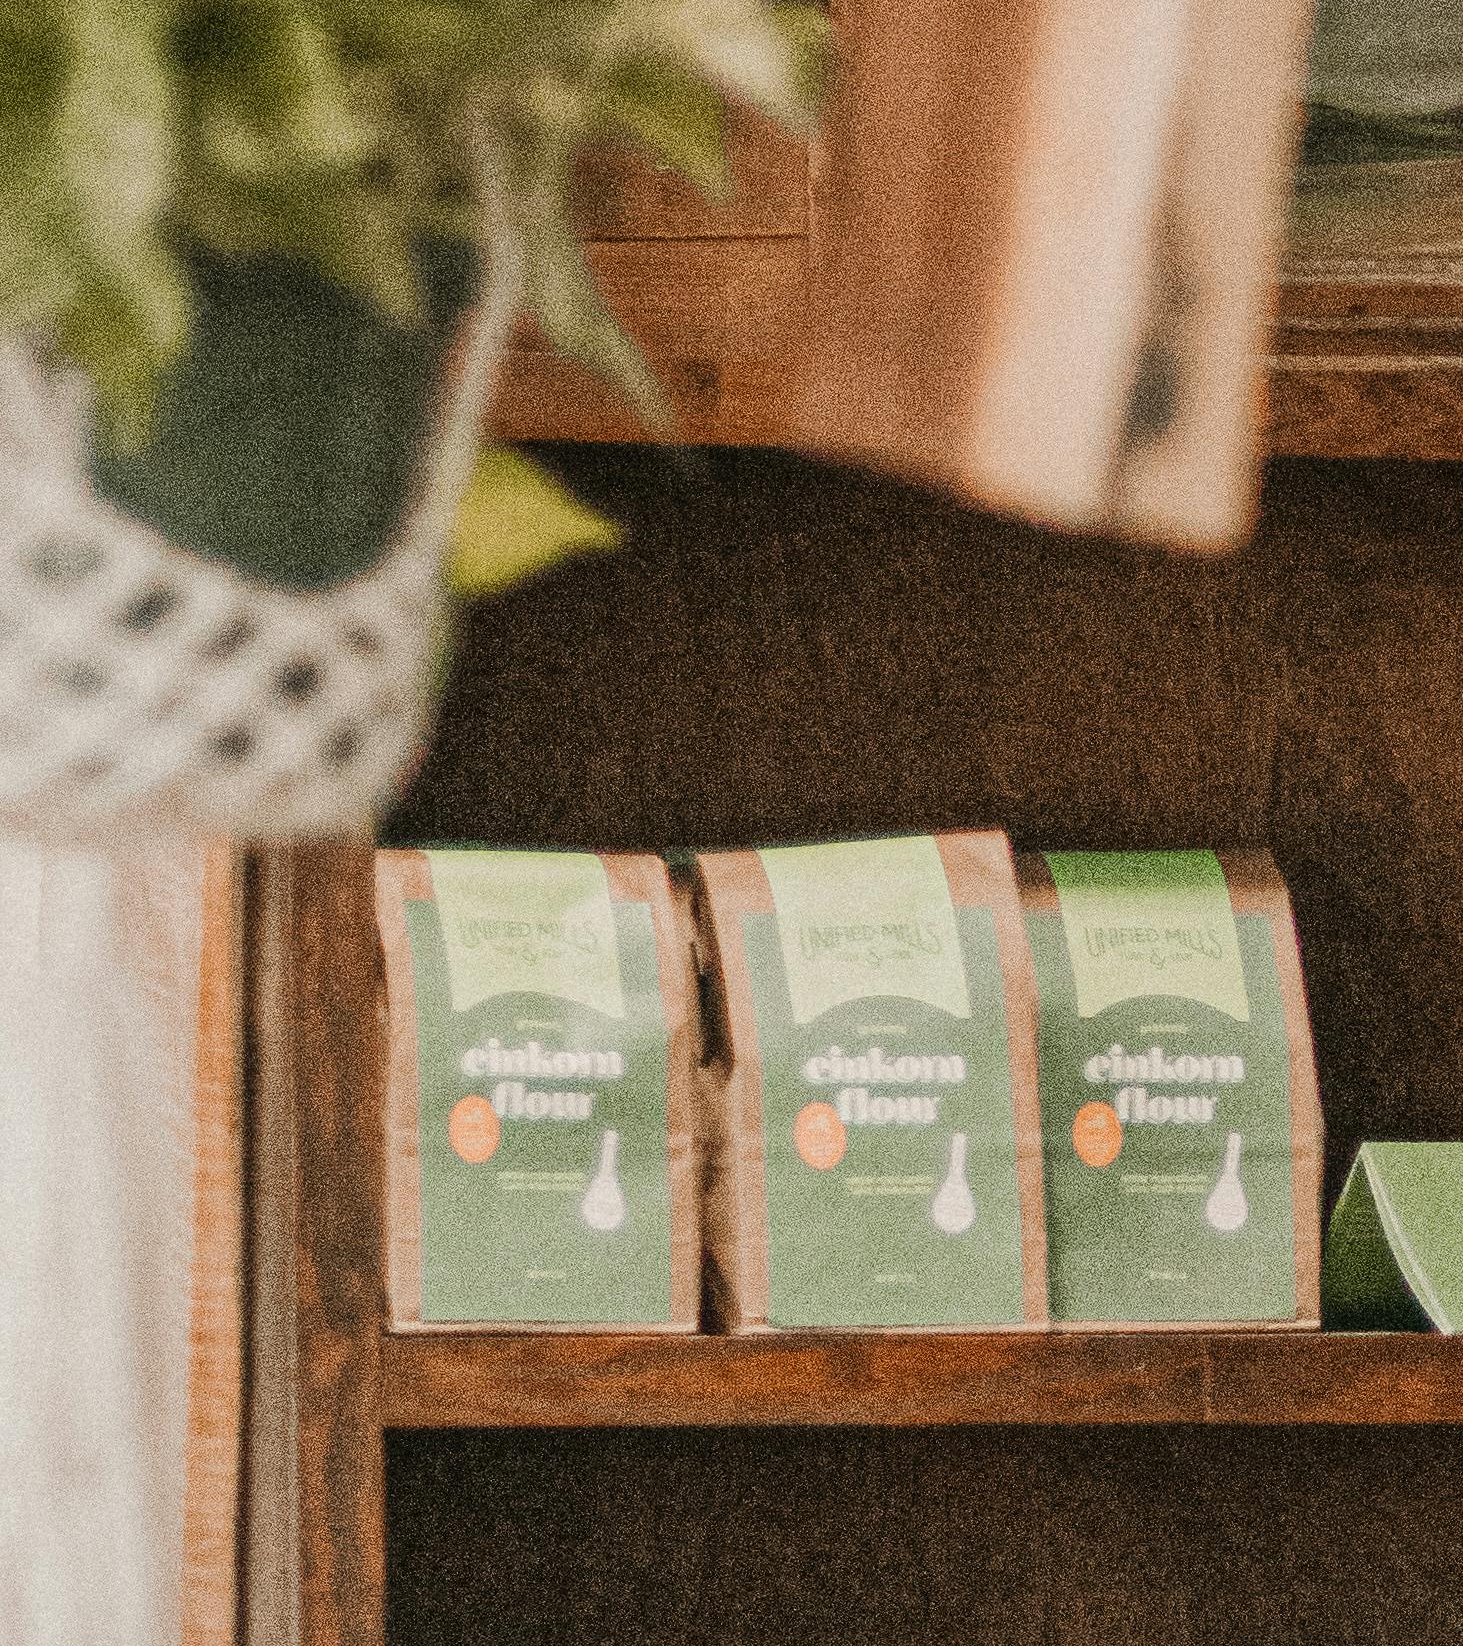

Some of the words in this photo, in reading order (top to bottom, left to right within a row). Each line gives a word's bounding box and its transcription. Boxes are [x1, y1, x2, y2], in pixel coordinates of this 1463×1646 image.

[463, 1041, 622, 1076] einkorn
[805, 1048, 965, 1084] einkorn
[1084, 1048, 1244, 1084] einkorn
[494, 1084, 592, 1120] flour
[836, 1089, 940, 1124] flour
[1115, 1086, 1217, 1124] flour
